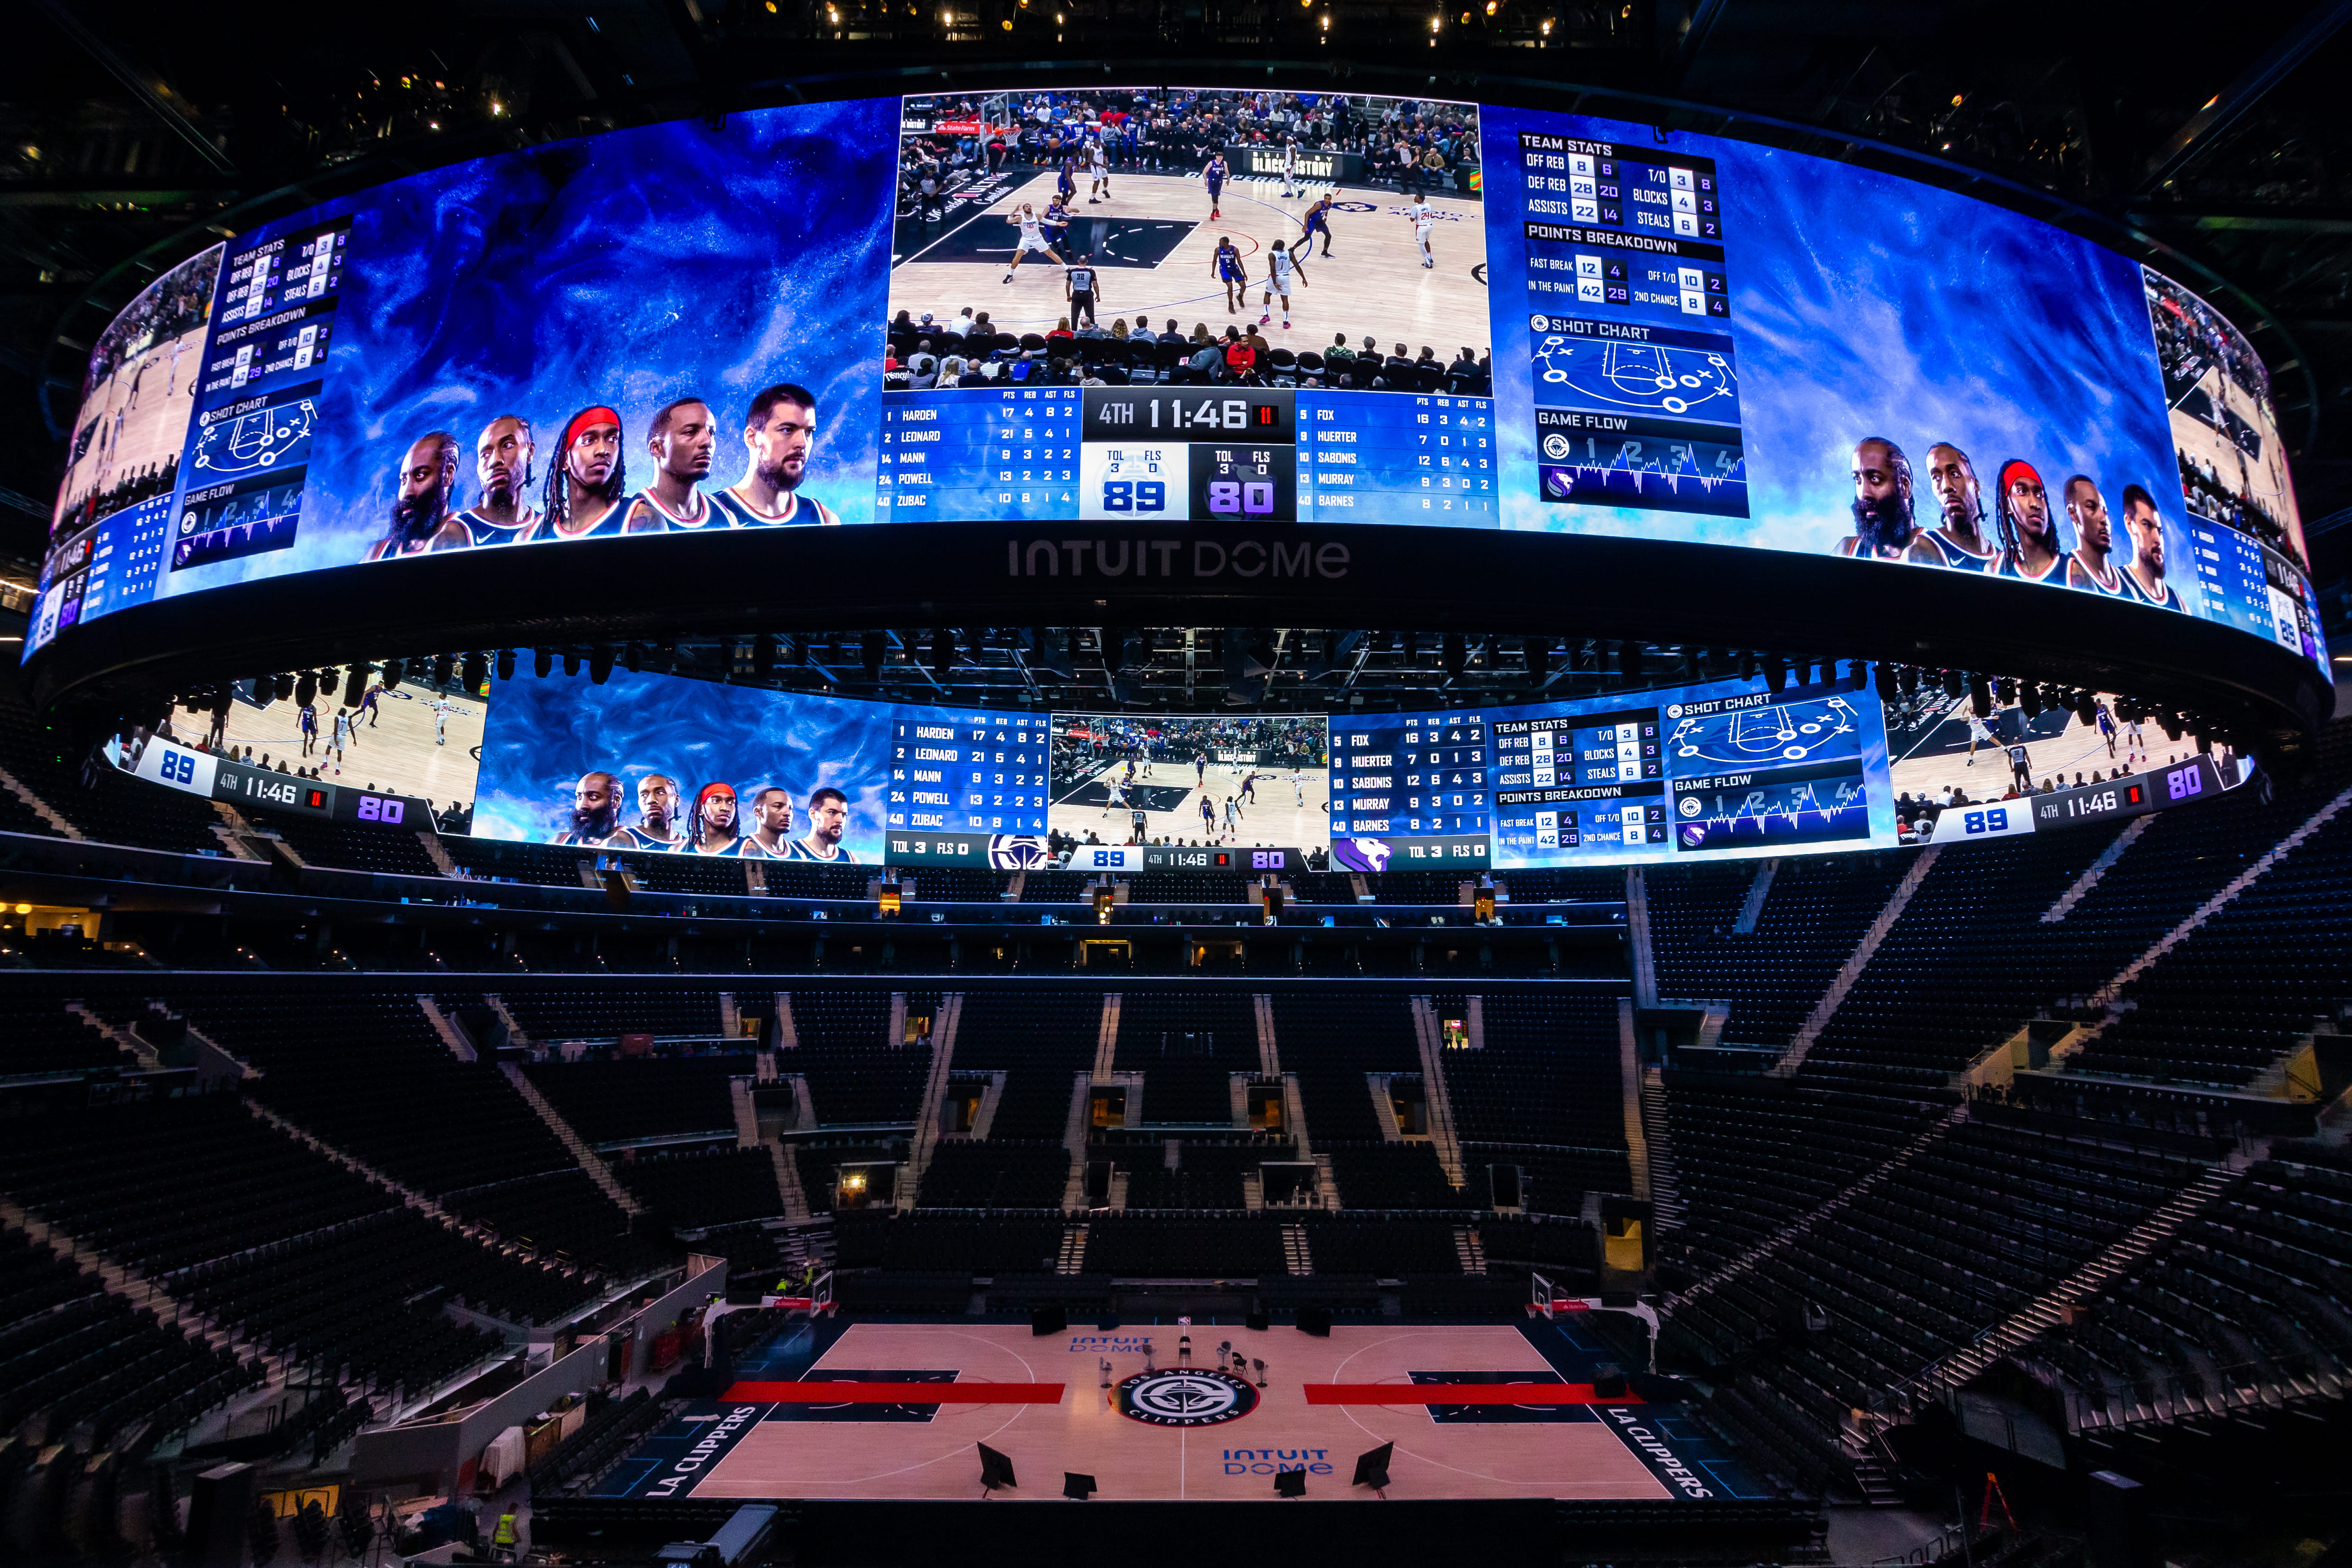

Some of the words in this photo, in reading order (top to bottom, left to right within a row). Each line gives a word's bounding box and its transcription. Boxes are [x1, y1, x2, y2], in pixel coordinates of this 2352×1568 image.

[1522, 135, 1563, 150] TEAM
[1568, 140, 1613, 157] STATS
[1253, 158, 1285, 172] BLACK
[1295, 160, 1333, 177] ISTORY
[1526, 153, 1543, 167] OFF
[1546, 155, 1564, 170] REB
[1648, 168, 1666, 183] T/O
[1528, 175, 1545, 189] DEF
[1548, 178, 1566, 191] REB
[1574, 182, 1593, 194] 28
[1600, 185, 1618, 198] 20
[1633, 188, 1668, 205] BLOCKS
[1528, 198, 1568, 215] ASSISTS
[1576, 206, 1594, 217] 22
[1604, 208, 1618, 220] 14
[1637, 211, 1670, 228] STEALS
[1529, 225, 1581, 241] POINTS
[1587, 231, 1677, 253] BREAKDOWN
[233, 250, 255, 266] TEAM
[257, 239, 285, 257] STATS
[1530, 257, 1548, 268] FAST
[1549, 259, 1574, 271] BREAK
[1582, 262, 1596, 274] 12
[1648, 270, 1661, 281] OFF
[1662, 272, 1676, 283] T/O
[1685, 275, 1698, 287] 10
[1528, 280, 1536, 290] IN
[1538, 280, 1552, 292] THE
[1554, 282, 1574, 294] PAINT
[1581, 285, 1600, 297] 42
[1608, 287, 1626, 300] 29
[1634, 291, 1649, 302] 2ND
[1651, 293, 1678, 306] CHANCE
[217, 326, 247, 345] POINTS
[249, 307, 306, 334] BREAKDOWN
[1552, 319, 1593, 334] SHOT
[1599, 324, 1650, 340] CHART
[1045, 390, 1057, 399] AST
[210, 406, 234, 421] SHOT
[236, 396, 268, 414] CHART
[1416, 397, 1428, 406] PTS
[1437, 398, 1449, 407] REB
[1476, 401, 1487, 409] FLS
[902, 409, 937, 421] HARDEN
[1002, 408, 1014, 417] 17
[1099, 403, 1134, 424] 4TH
[1150, 399, 1247, 429] 11:46
[1317, 409, 1334, 421] FOX
[1417, 414, 1429, 424] 16
[1539, 412, 1581, 427] GAME
[1586, 415, 1627, 430] FLOW
[901, 430, 940, 442] LEONARD
[1001, 429, 1013, 439] 21
[1318, 431, 1357, 443] HUERTER
[881, 454, 892, 464] 14
[899, 452, 925, 463] MANN
[1107, 450, 1124, 461] TOL
[1144, 450, 1161, 461] FLS
[1215, 450, 1233, 462] TOL
[1253, 451, 1270, 463] FLS
[1299, 452, 1309, 462] 10
[1318, 452, 1357, 464] SABONIS
[1418, 455, 1430, 465] 12
[1111, 463, 1119, 472] 3
[1149, 463, 1157, 472] 0
[1220, 463, 1229, 474] 3
[1257, 464, 1267, 475] 0
[879, 475, 892, 485] 24
[899, 473, 933, 484] POWELL
[1000, 471, 1012, 481] 13
[1300, 473, 1309, 484] 13
[1318, 473, 1354, 485] MURRAY
[185, 491, 208, 505] GAME
[209, 484, 234, 498] FLOW
[877, 497, 890, 506] 40
[897, 495, 926, 506] ZUBAC
[999, 493, 1011, 503] 10
[1103, 481, 1165, 511] 89
[1210, 481, 1273, 513] 80
[1298, 495, 1311, 505] 40
[1319, 495, 1354, 507] BARNES
[1685, 701, 1723, 715] SHOT
[1725, 693, 1771, 709] CHART
[917, 726, 954, 740] HARDEN
[1495, 722, 1528, 733] TEAM
[1531, 719, 1568, 731] STATS
[1351, 734, 1369, 746] FOX
[915, 748, 958, 762] LEONARD
[1351, 755, 1392, 767] HUERTER
[1584, 748, 1614, 761] BLOCKS
[914, 770, 942, 783] MANN
[1499, 773, 1531, 785] ASSISTS
[1587, 767, 1616, 779] STEALS
[160, 749, 195, 785] 89
[219, 772, 237, 790] 4TH
[246, 777, 297, 804] 11:46
[358, 796, 404, 824] 80
[1352, 776, 1392, 789] SABONIS
[1675, 779, 1711, 791] GAME
[1715, 774, 1751, 787] FLOW
[912, 791, 950, 805] POWELL
[1499, 792, 1541, 803] POINTS
[1545, 786, 1621, 801] BREAKDOWN
[1964, 808, 2008, 835] 89
[2040, 804, 2059, 819] 4TH
[2068, 790, 2117, 817] 11:46
[2167, 764, 2202, 800] 80
[1353, 798, 1390, 810] MURRAY
[911, 813, 943, 827] ZUBAC
[1353, 819, 1390, 832] BARNES
[1500, 819, 1514, 828] FAST
[1515, 818, 1534, 827] BREAK
[892, 840, 910, 853] TOL
[937, 842, 954, 854] FLS
[1409, 846, 1426, 858] TOL
[1453, 845, 1470, 857] FLS
[1093, 851, 1124, 867] 89
[1148, 854, 1162, 864] 4TH
[1170, 853, 1207, 866] 11:46
[1252, 851, 1284, 868] 80
[1122, 1375, 1149, 1389] LOS
[1164, 1369, 1246, 1390] ANGELES
[1129, 1409, 1239, 1425] CLIPPERS
[645, 1476, 688, 1496] LA
[674, 1406, 756, 1472] CLIPPERS
[1607, 1409, 1638, 1424] LA
[1627, 1427, 1713, 1498] CLIPPERS
